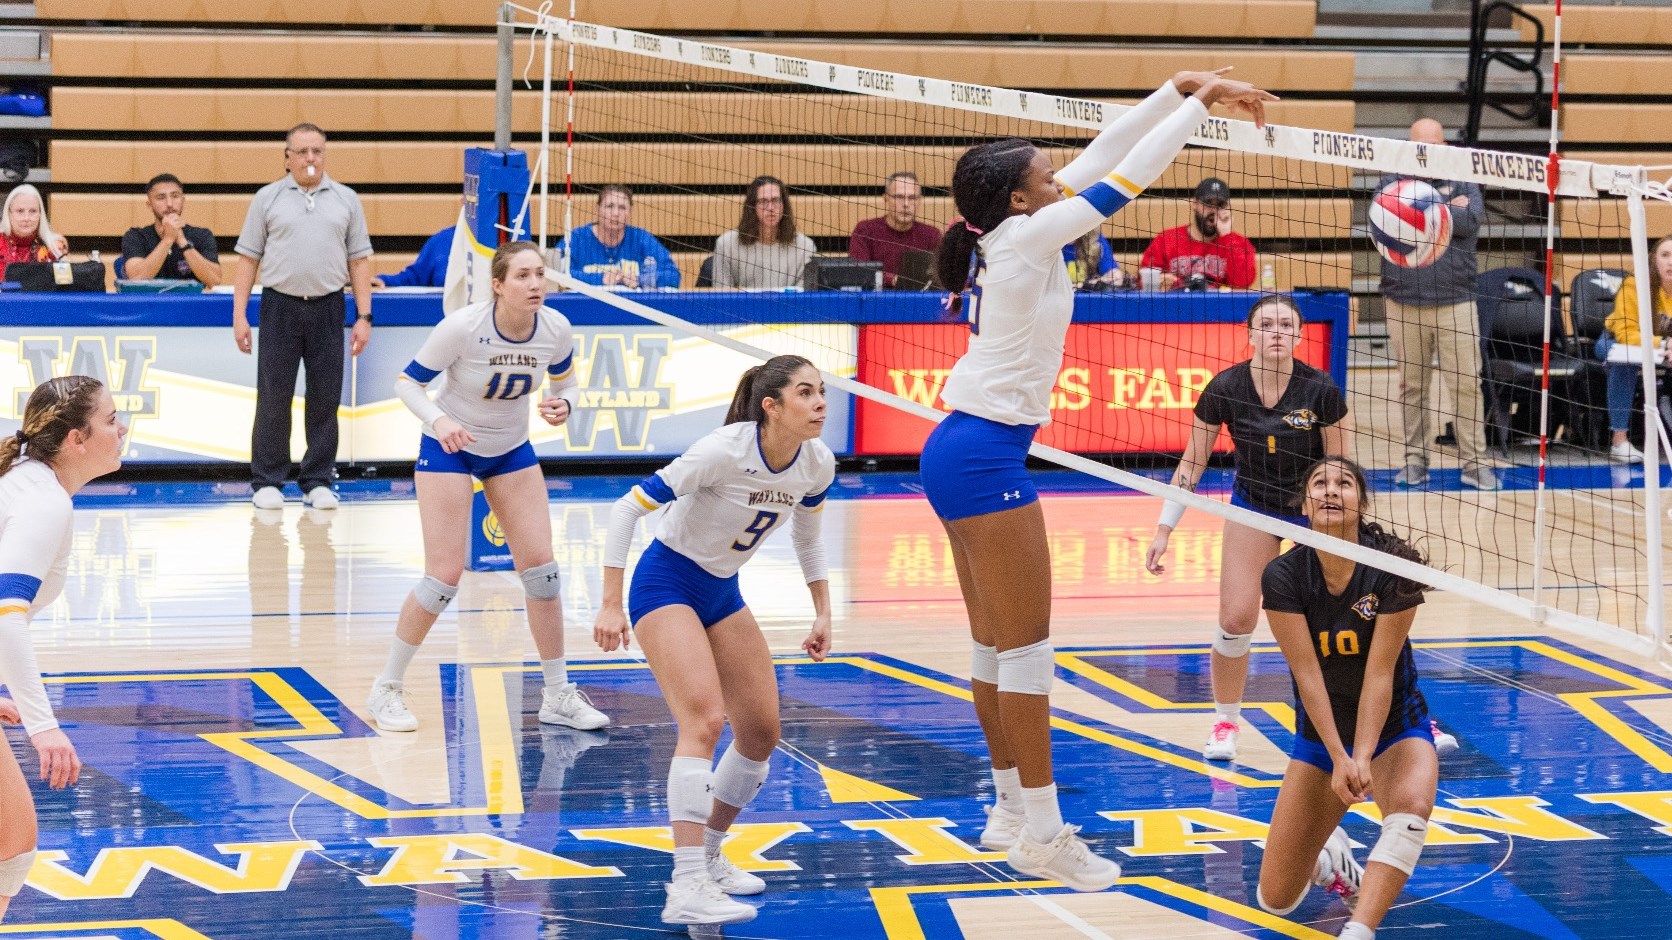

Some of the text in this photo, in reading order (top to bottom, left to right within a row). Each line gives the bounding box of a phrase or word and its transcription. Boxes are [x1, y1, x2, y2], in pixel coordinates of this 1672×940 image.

[701, 45, 732, 65] PIONEERS
[775, 57, 808, 78] PIONEERS
[857, 69, 895, 92] PIONEERS
[951, 83, 993, 107] PIONEERS
[1055, 98, 1103, 123] PIONEERS
[1313, 131, 1374, 162] PIONEERS
[1471, 151, 1545, 183] PIONEERS
[489, 354, 538, 368] WAYLAND
[483, 370, 533, 401] 10
[577, 390, 660, 408] AYLAND
[1267, 435, 1276, 454] 1
[747, 489, 795, 507] WAYLAND
[729, 509, 780, 552] 9
[1319, 630, 1360, 657] 10
